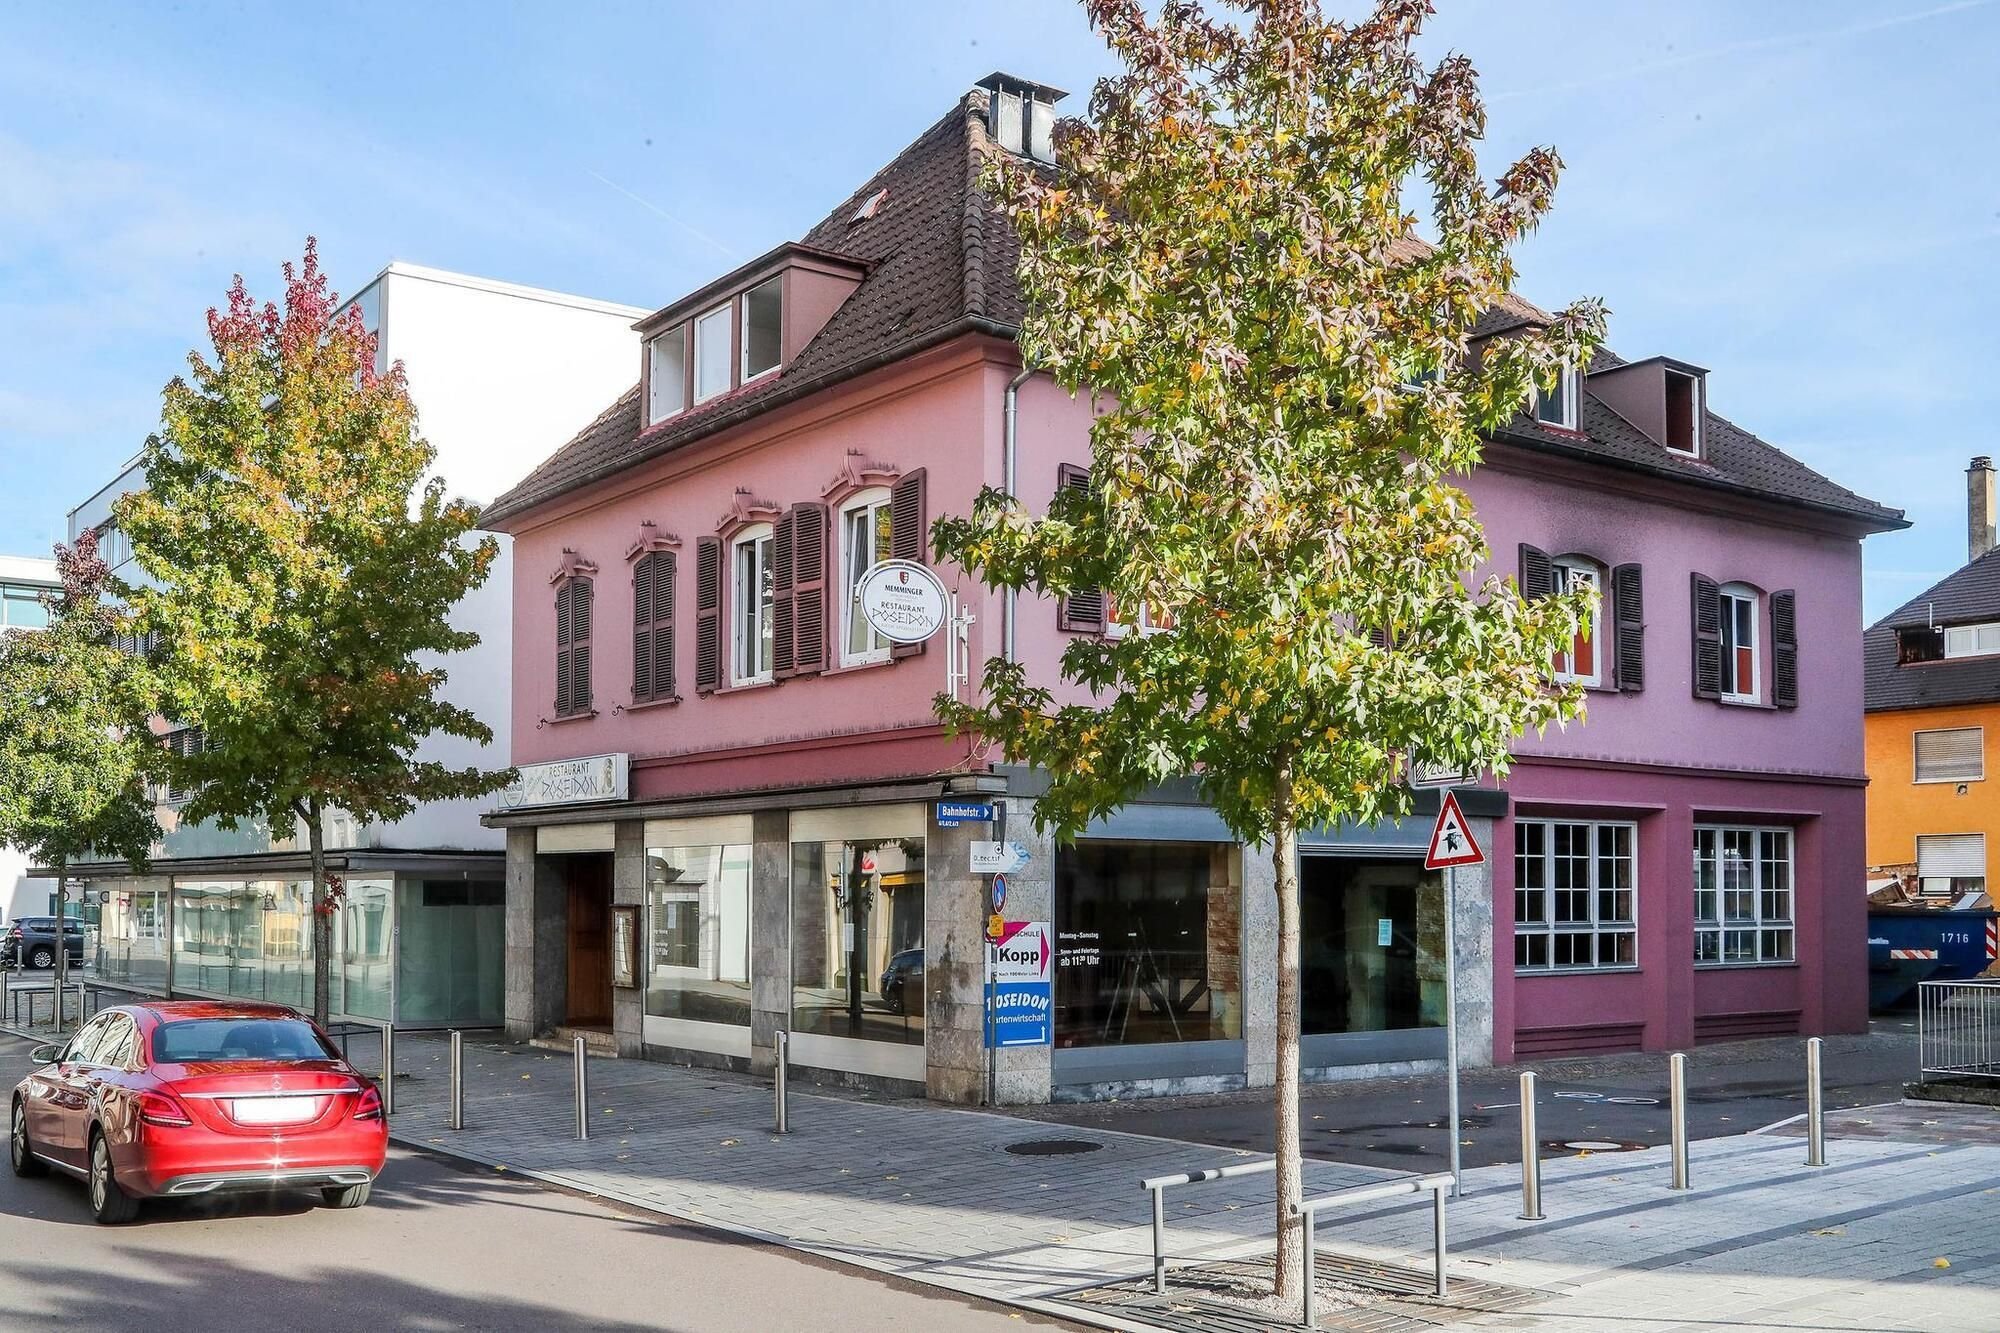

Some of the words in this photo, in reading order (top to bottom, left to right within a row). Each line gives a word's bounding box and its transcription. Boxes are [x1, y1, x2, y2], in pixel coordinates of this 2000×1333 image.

[885, 584, 923, 596] MEMMINGER
[880, 601, 925, 614] RESTAURANT
[872, 607, 934, 627] POSEIDON
[549, 761, 590, 777] RESTAURANT
[942, 805, 981, 818] Bahnhofstr.
[1941, 932, 1969, 944] 1716
[999, 947, 1040, 965] Kopp
[1060, 956, 1070, 966] ab
[1087, 955, 1100, 965] Uhr
